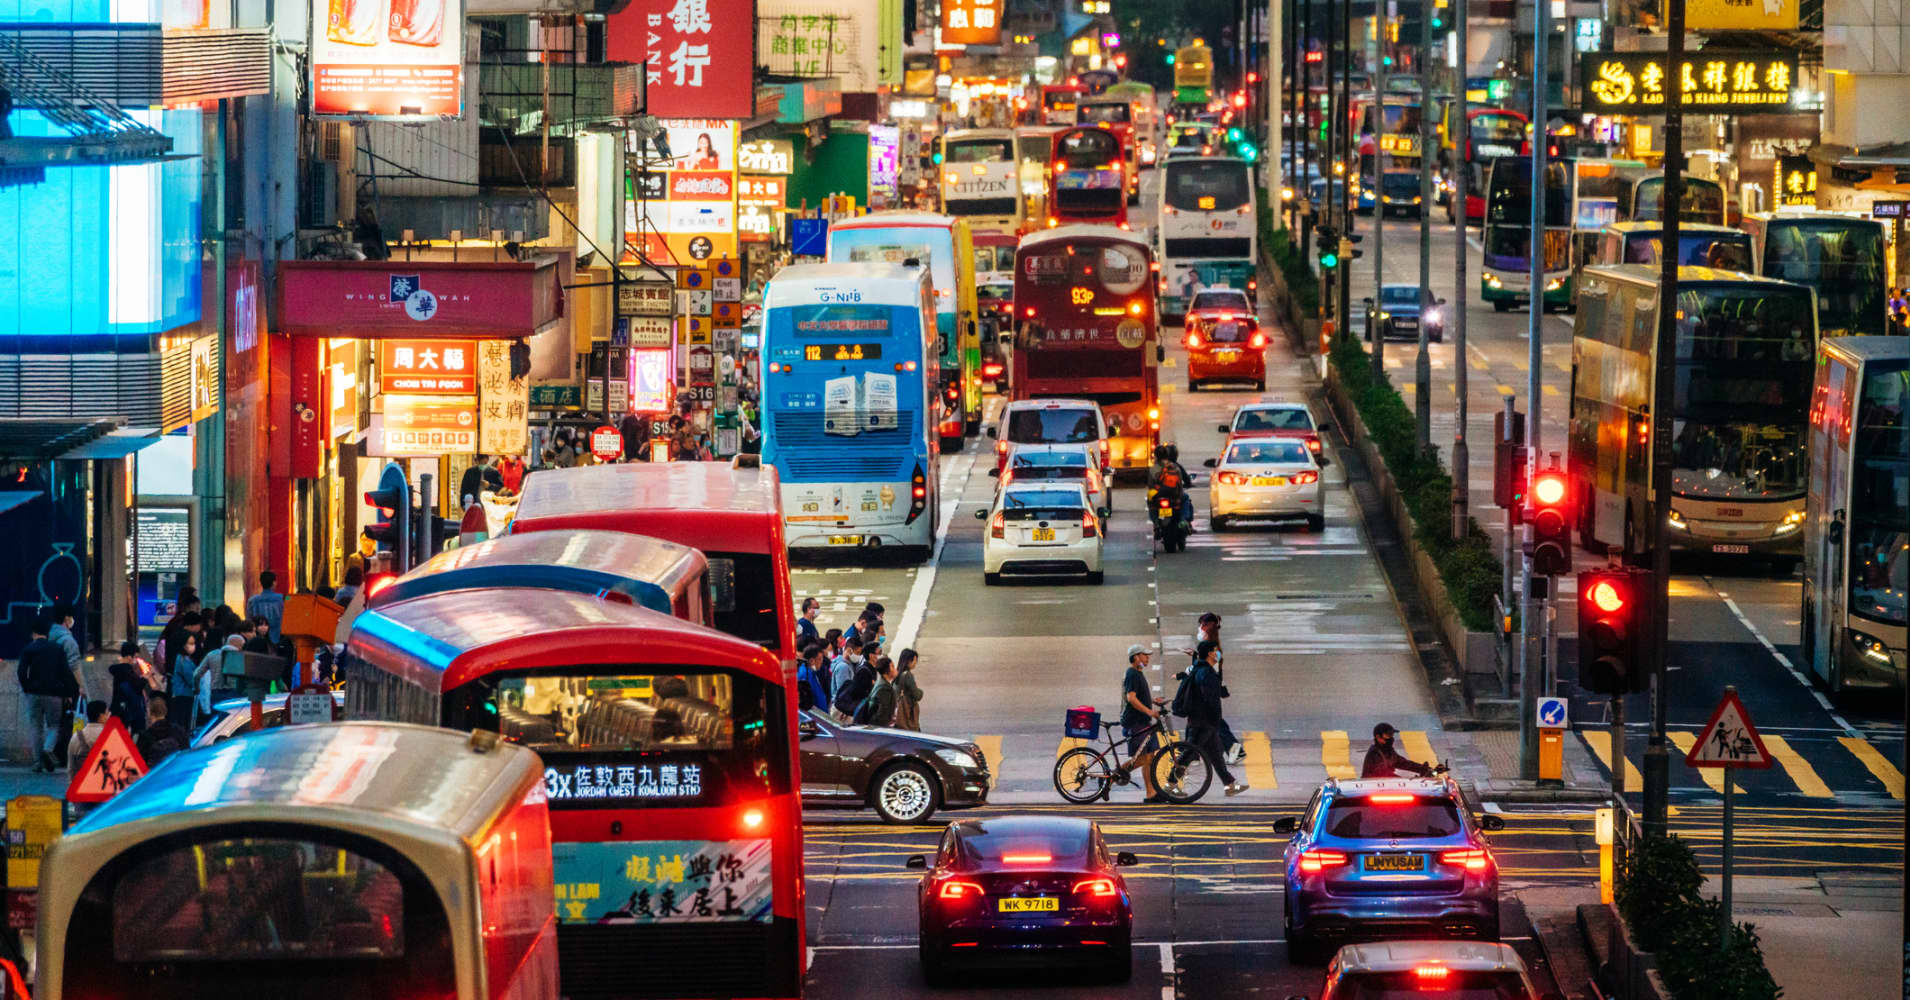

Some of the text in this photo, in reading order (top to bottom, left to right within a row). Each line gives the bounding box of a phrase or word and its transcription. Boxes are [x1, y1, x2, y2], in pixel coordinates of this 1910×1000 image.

[647, 14, 661, 86] BANK
[667, 0, 712, 86] 銀行
[1642, 93, 1664, 104] LAO
[1695, 93, 1729, 104] XIANG
[393, 347, 465, 370] 周大福
[806, 345, 821, 360] 112
[689, 387, 714, 400] S16
[575, 764, 701, 786] 佐敦西九龍站
[574, 785, 606, 797] JORDAN
[639, 785, 677, 796] KOWLOON
[629, 887, 745, 917] 後來居上
[1004, 899, 1054, 910] WK 9718
